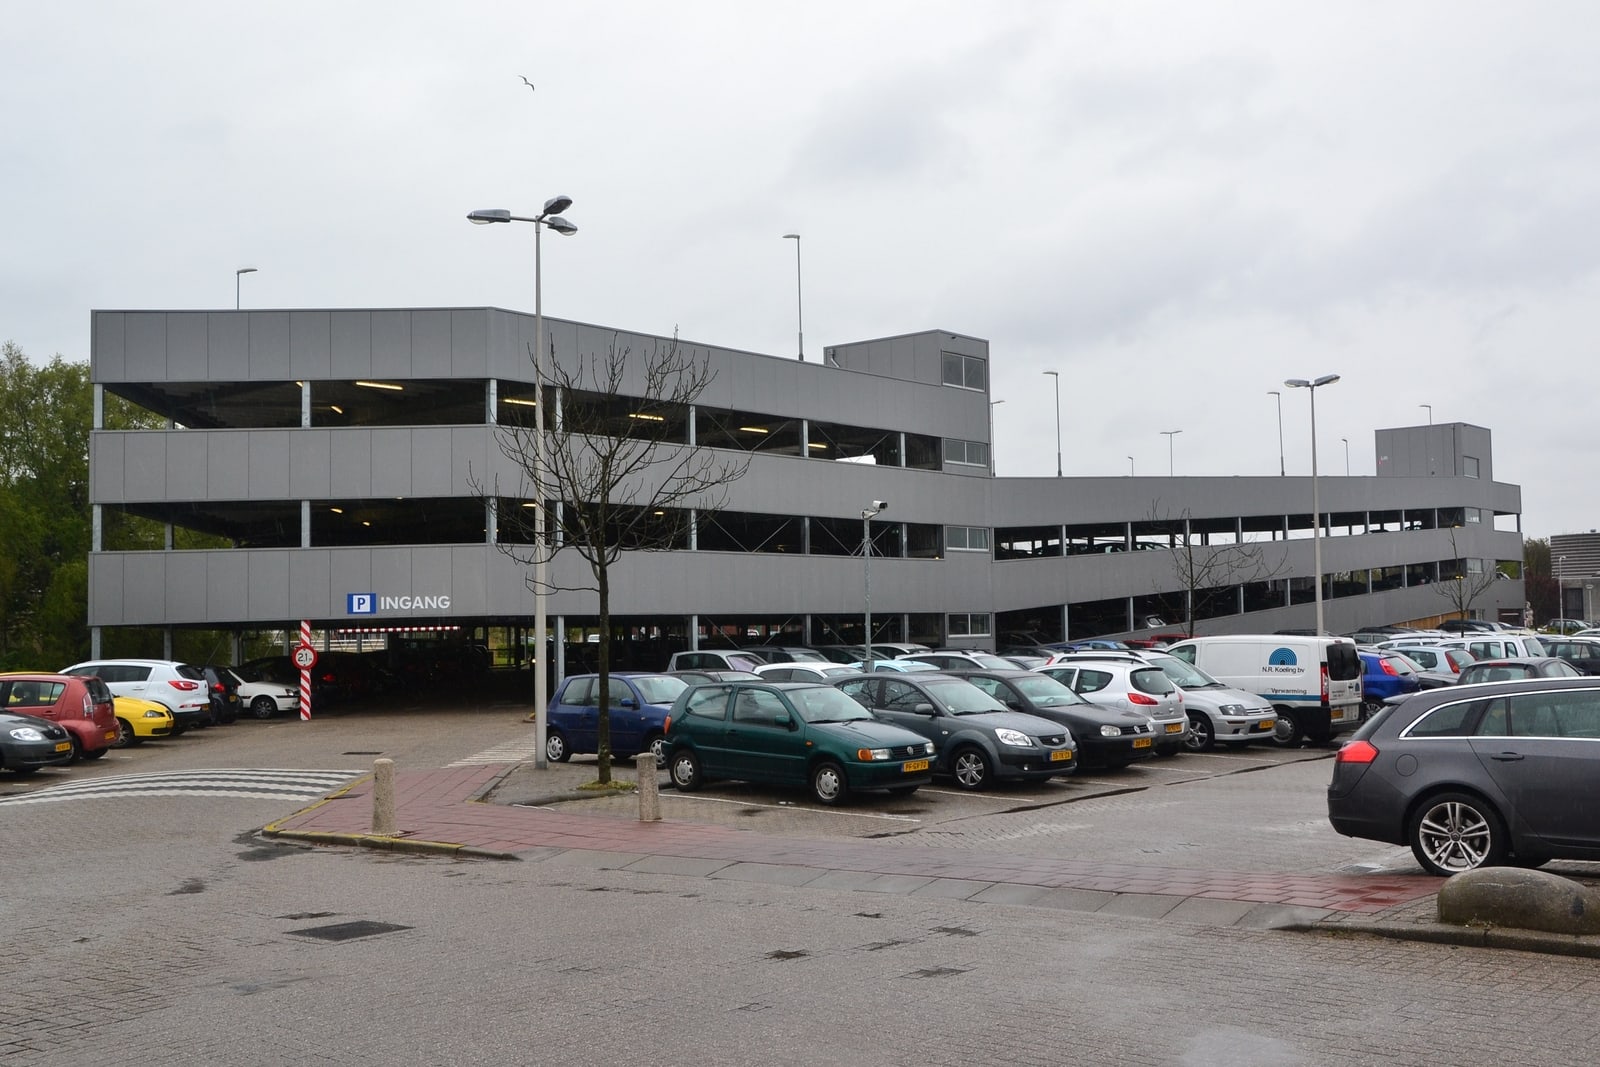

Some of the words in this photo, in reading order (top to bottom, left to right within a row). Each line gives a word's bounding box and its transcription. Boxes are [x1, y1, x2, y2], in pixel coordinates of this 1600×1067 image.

[380, 596, 450, 610] INGANG
[1274, 666, 1297, 674] Koeling
[1270, 687, 1307, 695] Verwarming
